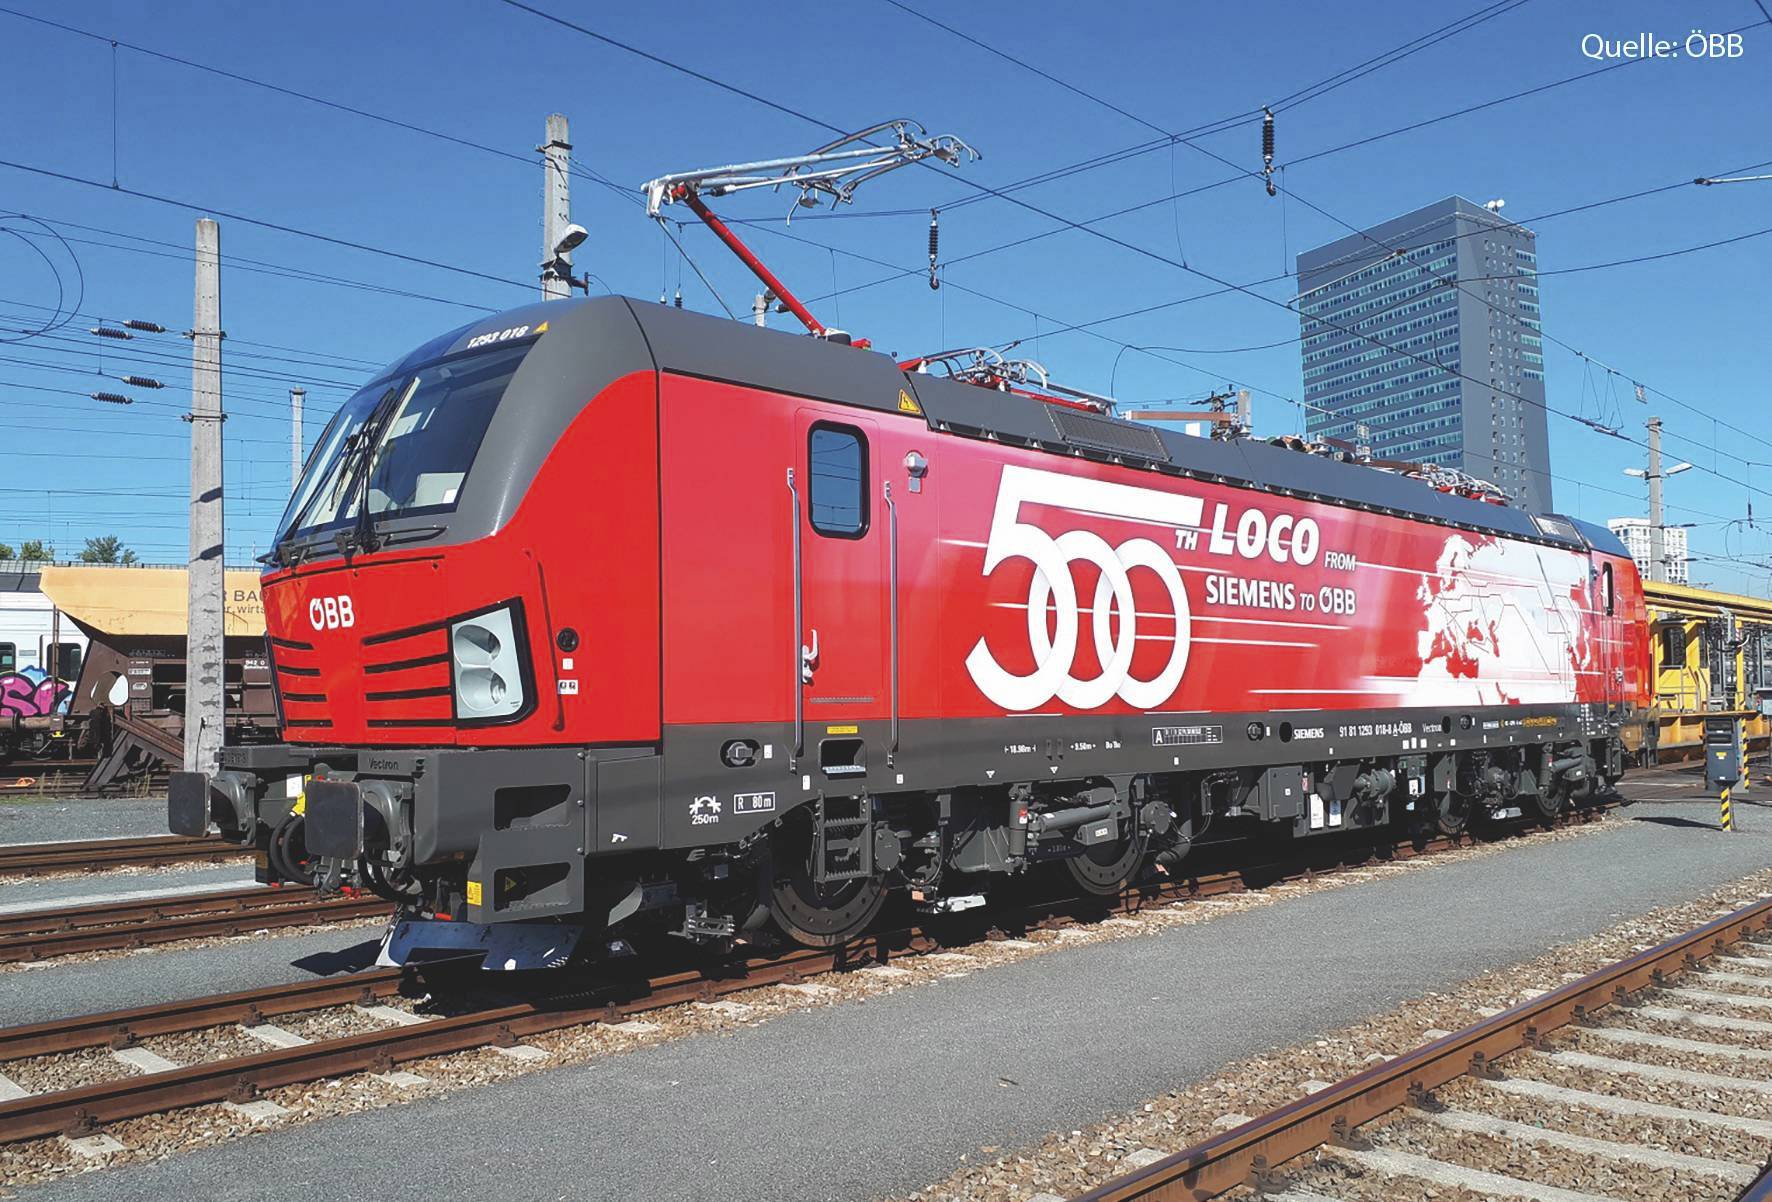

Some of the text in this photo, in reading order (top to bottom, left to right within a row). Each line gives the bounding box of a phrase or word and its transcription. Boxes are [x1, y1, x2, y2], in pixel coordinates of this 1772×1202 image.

[467, 325, 529, 348] 1293 018
[1209, 503, 1356, 571] LOCO FROM
[964, 464, 1204, 711] 500 TH
[1206, 575, 1356, 615] SIEMENS TO ÖBB
[309, 595, 355, 631] ÖBB
[1155, 730, 1163, 744] A
[1294, 728, 1324, 739] SIEMENS
[1339, 726, 1347, 737] 91
[1348, 725, 1356, 737] 81
[1358, 725, 1373, 736] 1293
[368, 757, 399, 770] Vectron
[738, 797, 744, 810] R
[692, 813, 719, 825] 250m
